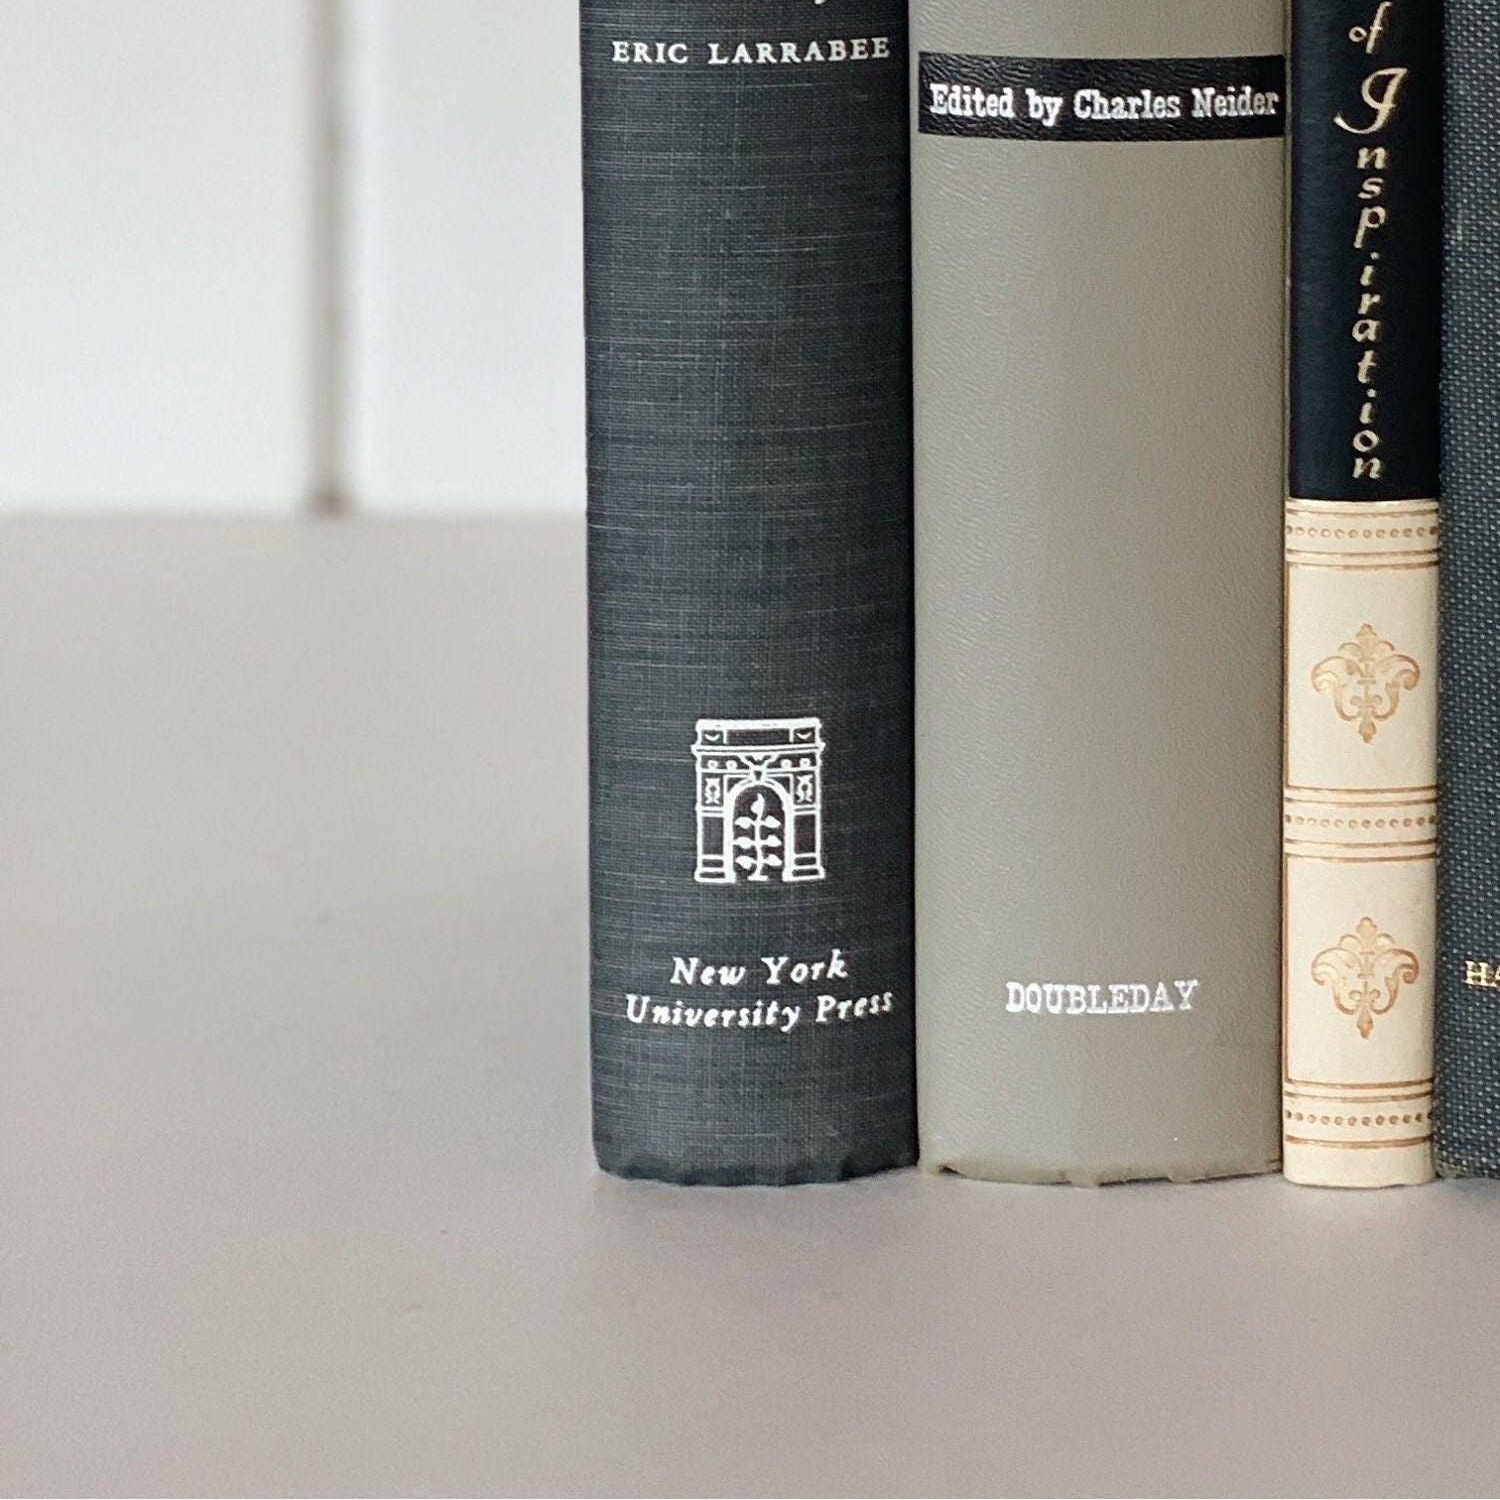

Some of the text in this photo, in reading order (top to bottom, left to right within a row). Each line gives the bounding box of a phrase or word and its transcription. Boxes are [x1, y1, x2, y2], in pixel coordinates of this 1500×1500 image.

[1348, 1, 1392, 54] of
[611, 37, 891, 65] ERIC LARRABEE
[929, 82, 1280, 125] Edited by Charles Neider
[1333, 67, 1408, 480] Inspiration
[670, 950, 848, 986] New York
[626, 991, 893, 1032] University Press
[1005, 980, 1198, 1014] DOUBLEDAY
